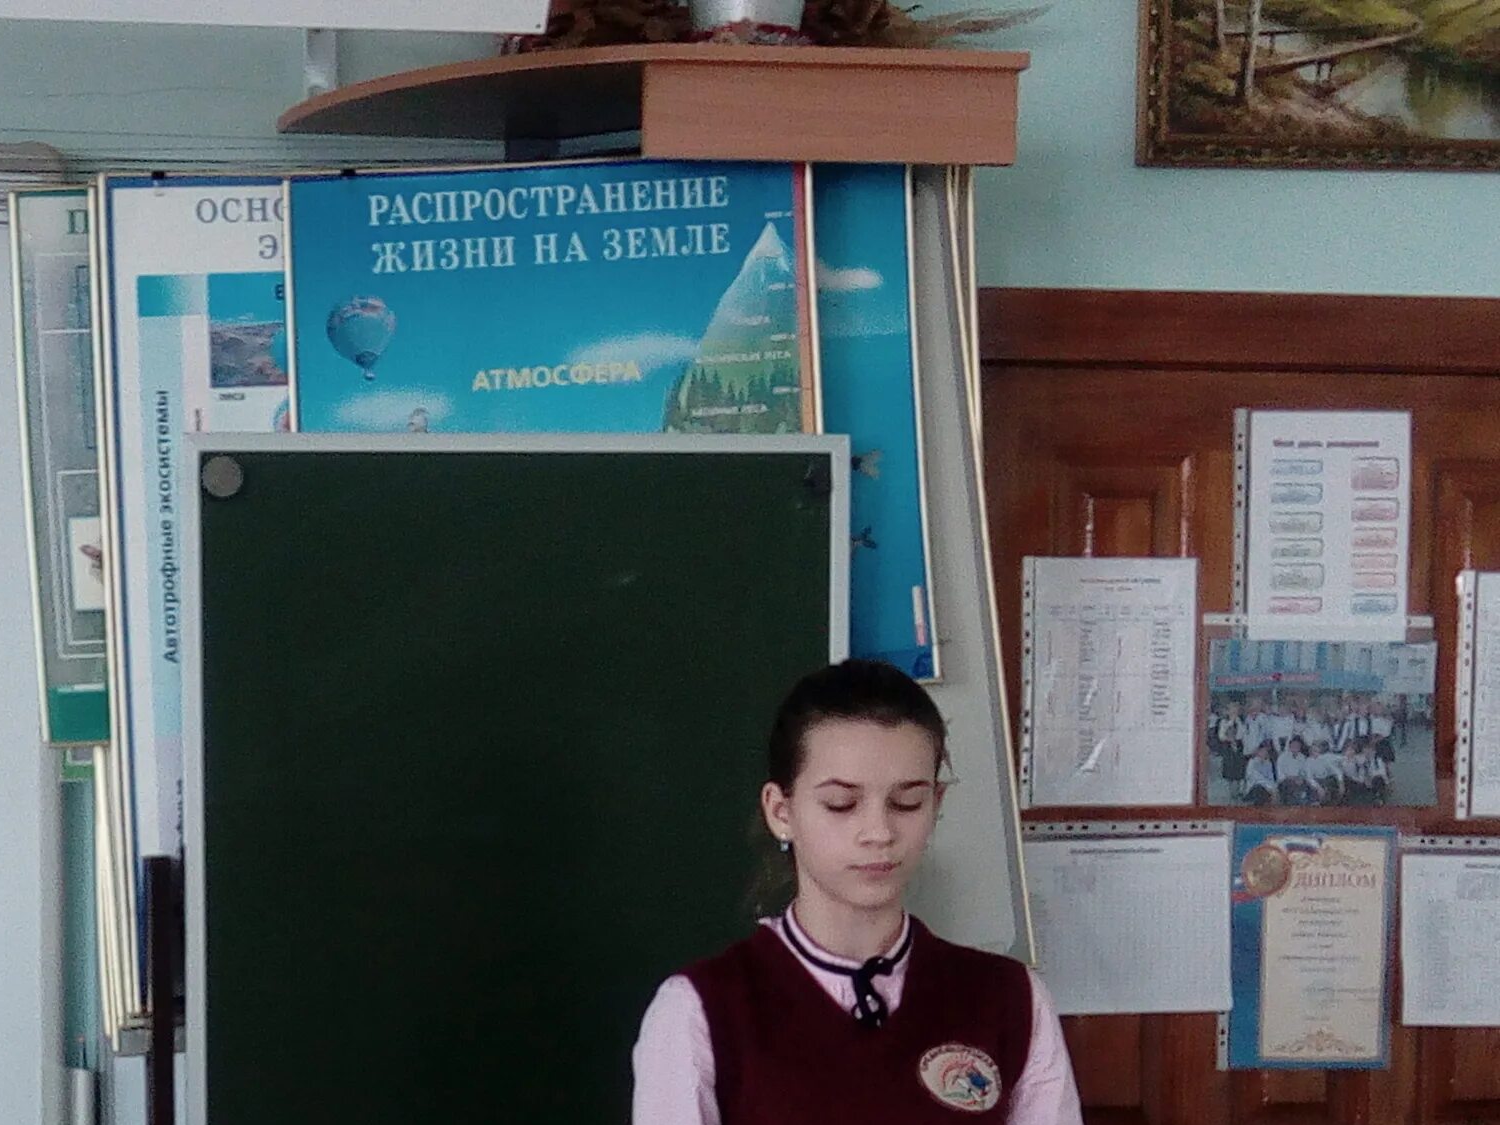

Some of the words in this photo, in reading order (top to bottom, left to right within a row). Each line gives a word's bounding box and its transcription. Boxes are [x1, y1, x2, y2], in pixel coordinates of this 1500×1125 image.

[368, 176, 730, 226] РАСПРОСТРАНЕНИЕ
[372, 235, 516, 274] ЖИЗНИ
[533, 232, 588, 265] НА
[603, 223, 731, 262] ЗЕМЛЕ
[472, 361, 642, 392] АТМОСФЕРА
[155, 389, 175, 514] экосистемы
[159, 519, 181, 664] Автотрофные
